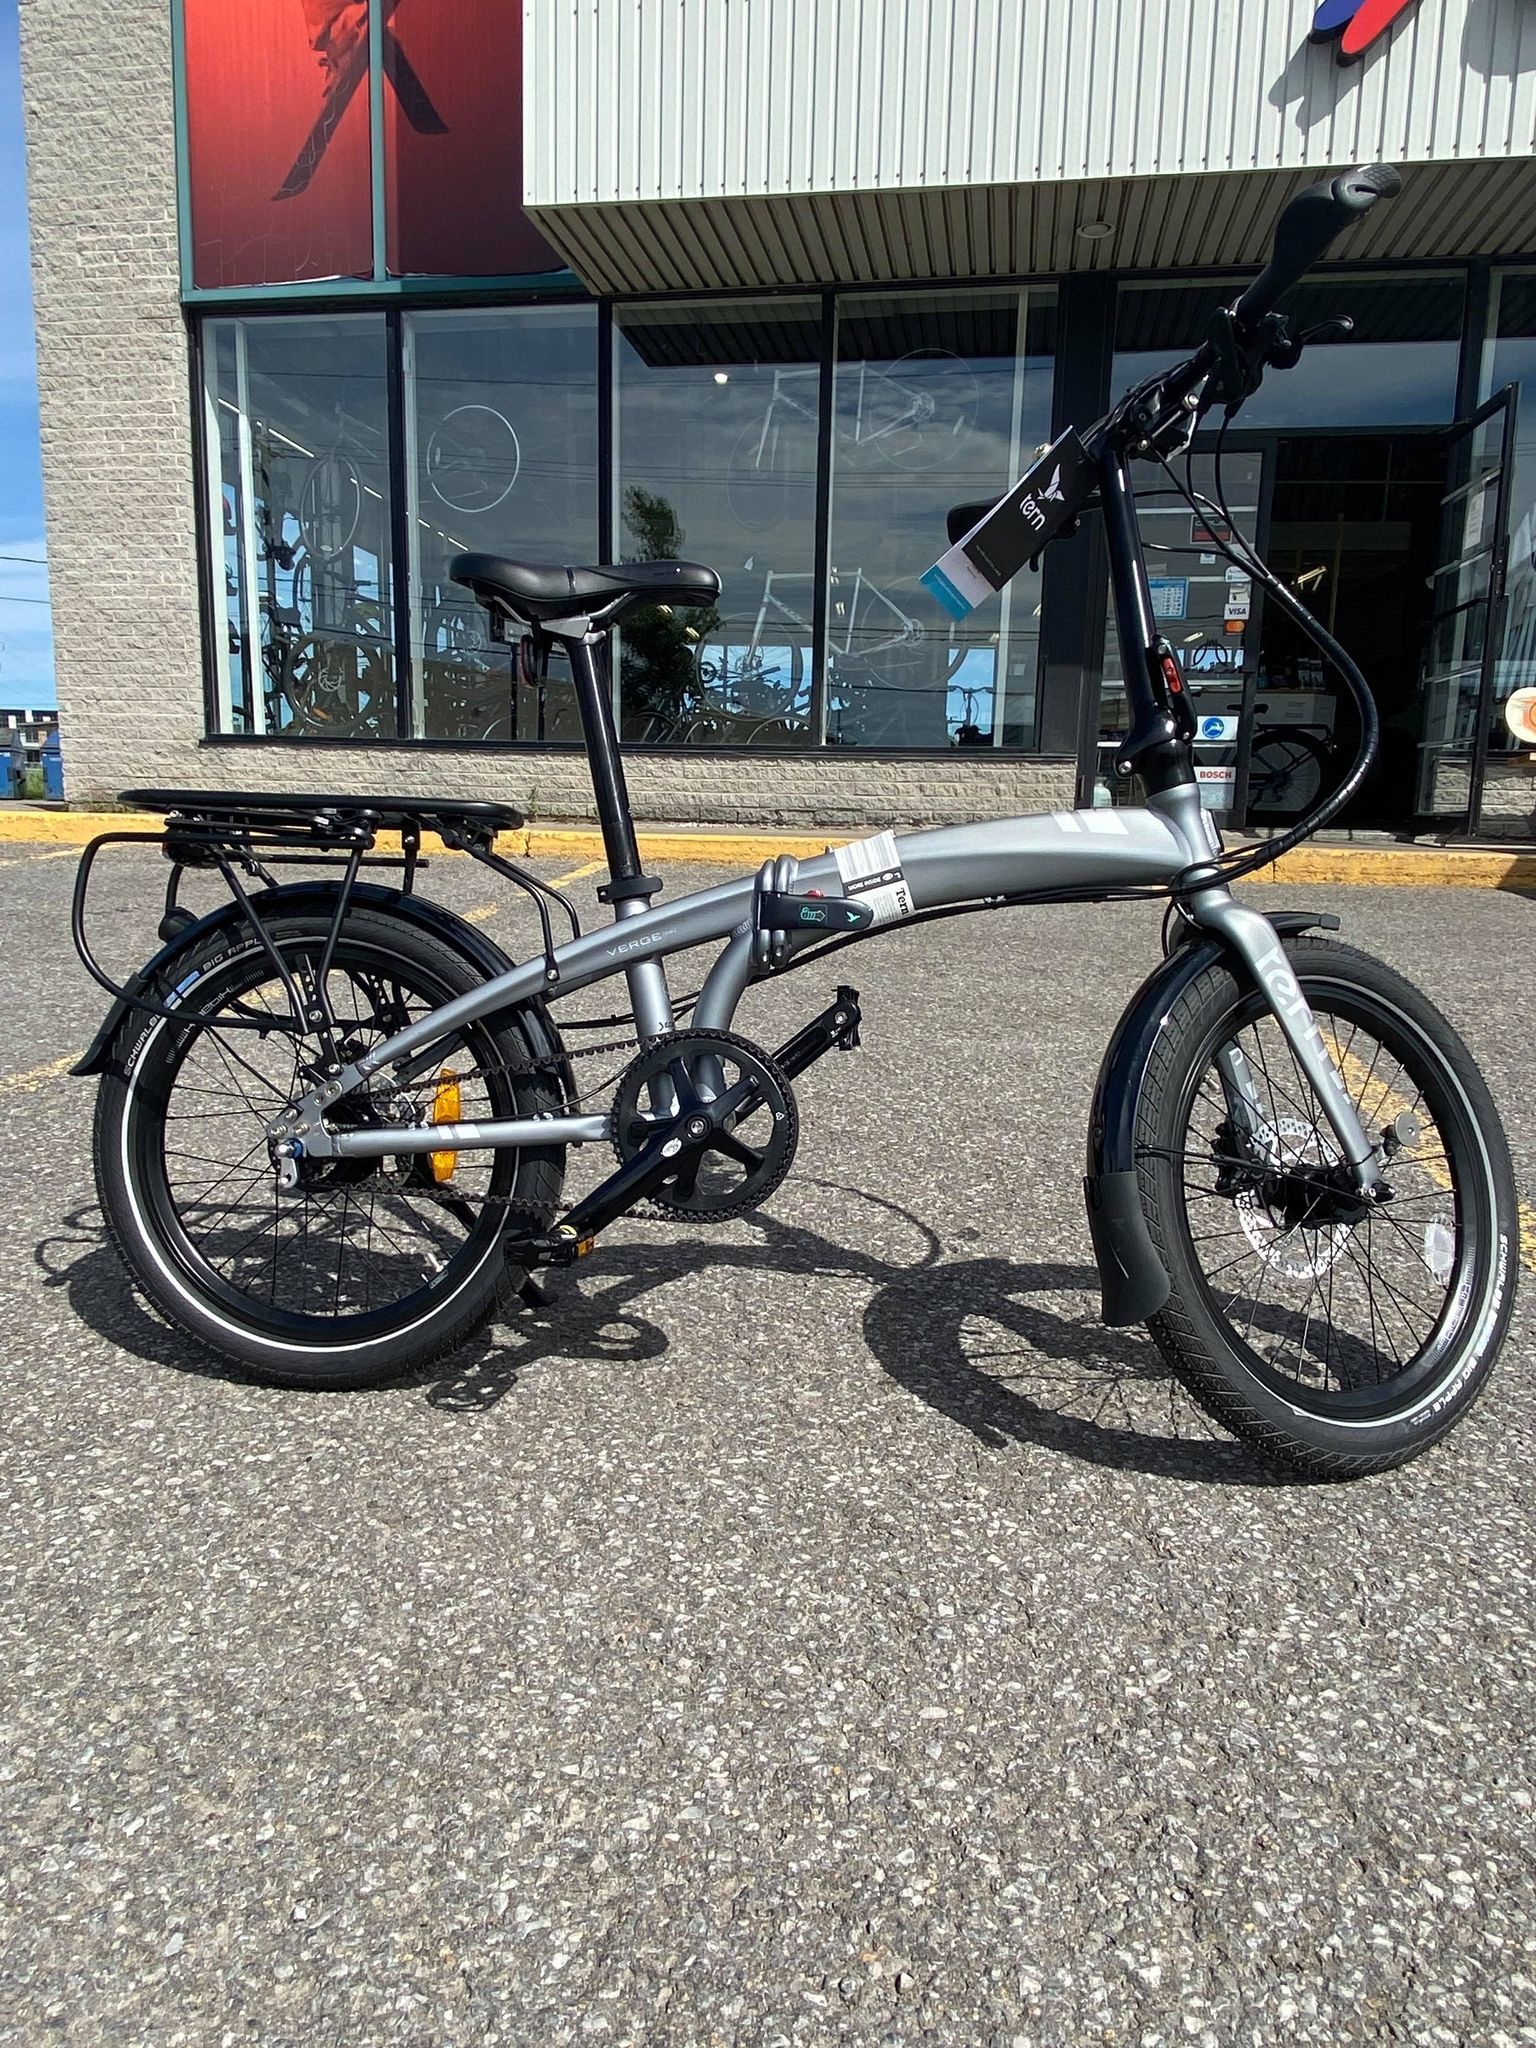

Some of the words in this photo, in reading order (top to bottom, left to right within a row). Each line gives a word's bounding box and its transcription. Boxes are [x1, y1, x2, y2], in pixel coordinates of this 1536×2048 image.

[1228, 607, 1247, 616] VISA
[1199, 770, 1233, 779] BOSCH
[895, 887, 910, 916] Tern
[202, 953, 224, 972] BIG
[227, 937, 264, 957] APPL
[606, 932, 663, 957] VERGE
[1432, 1380, 1464, 1413] APPLE
